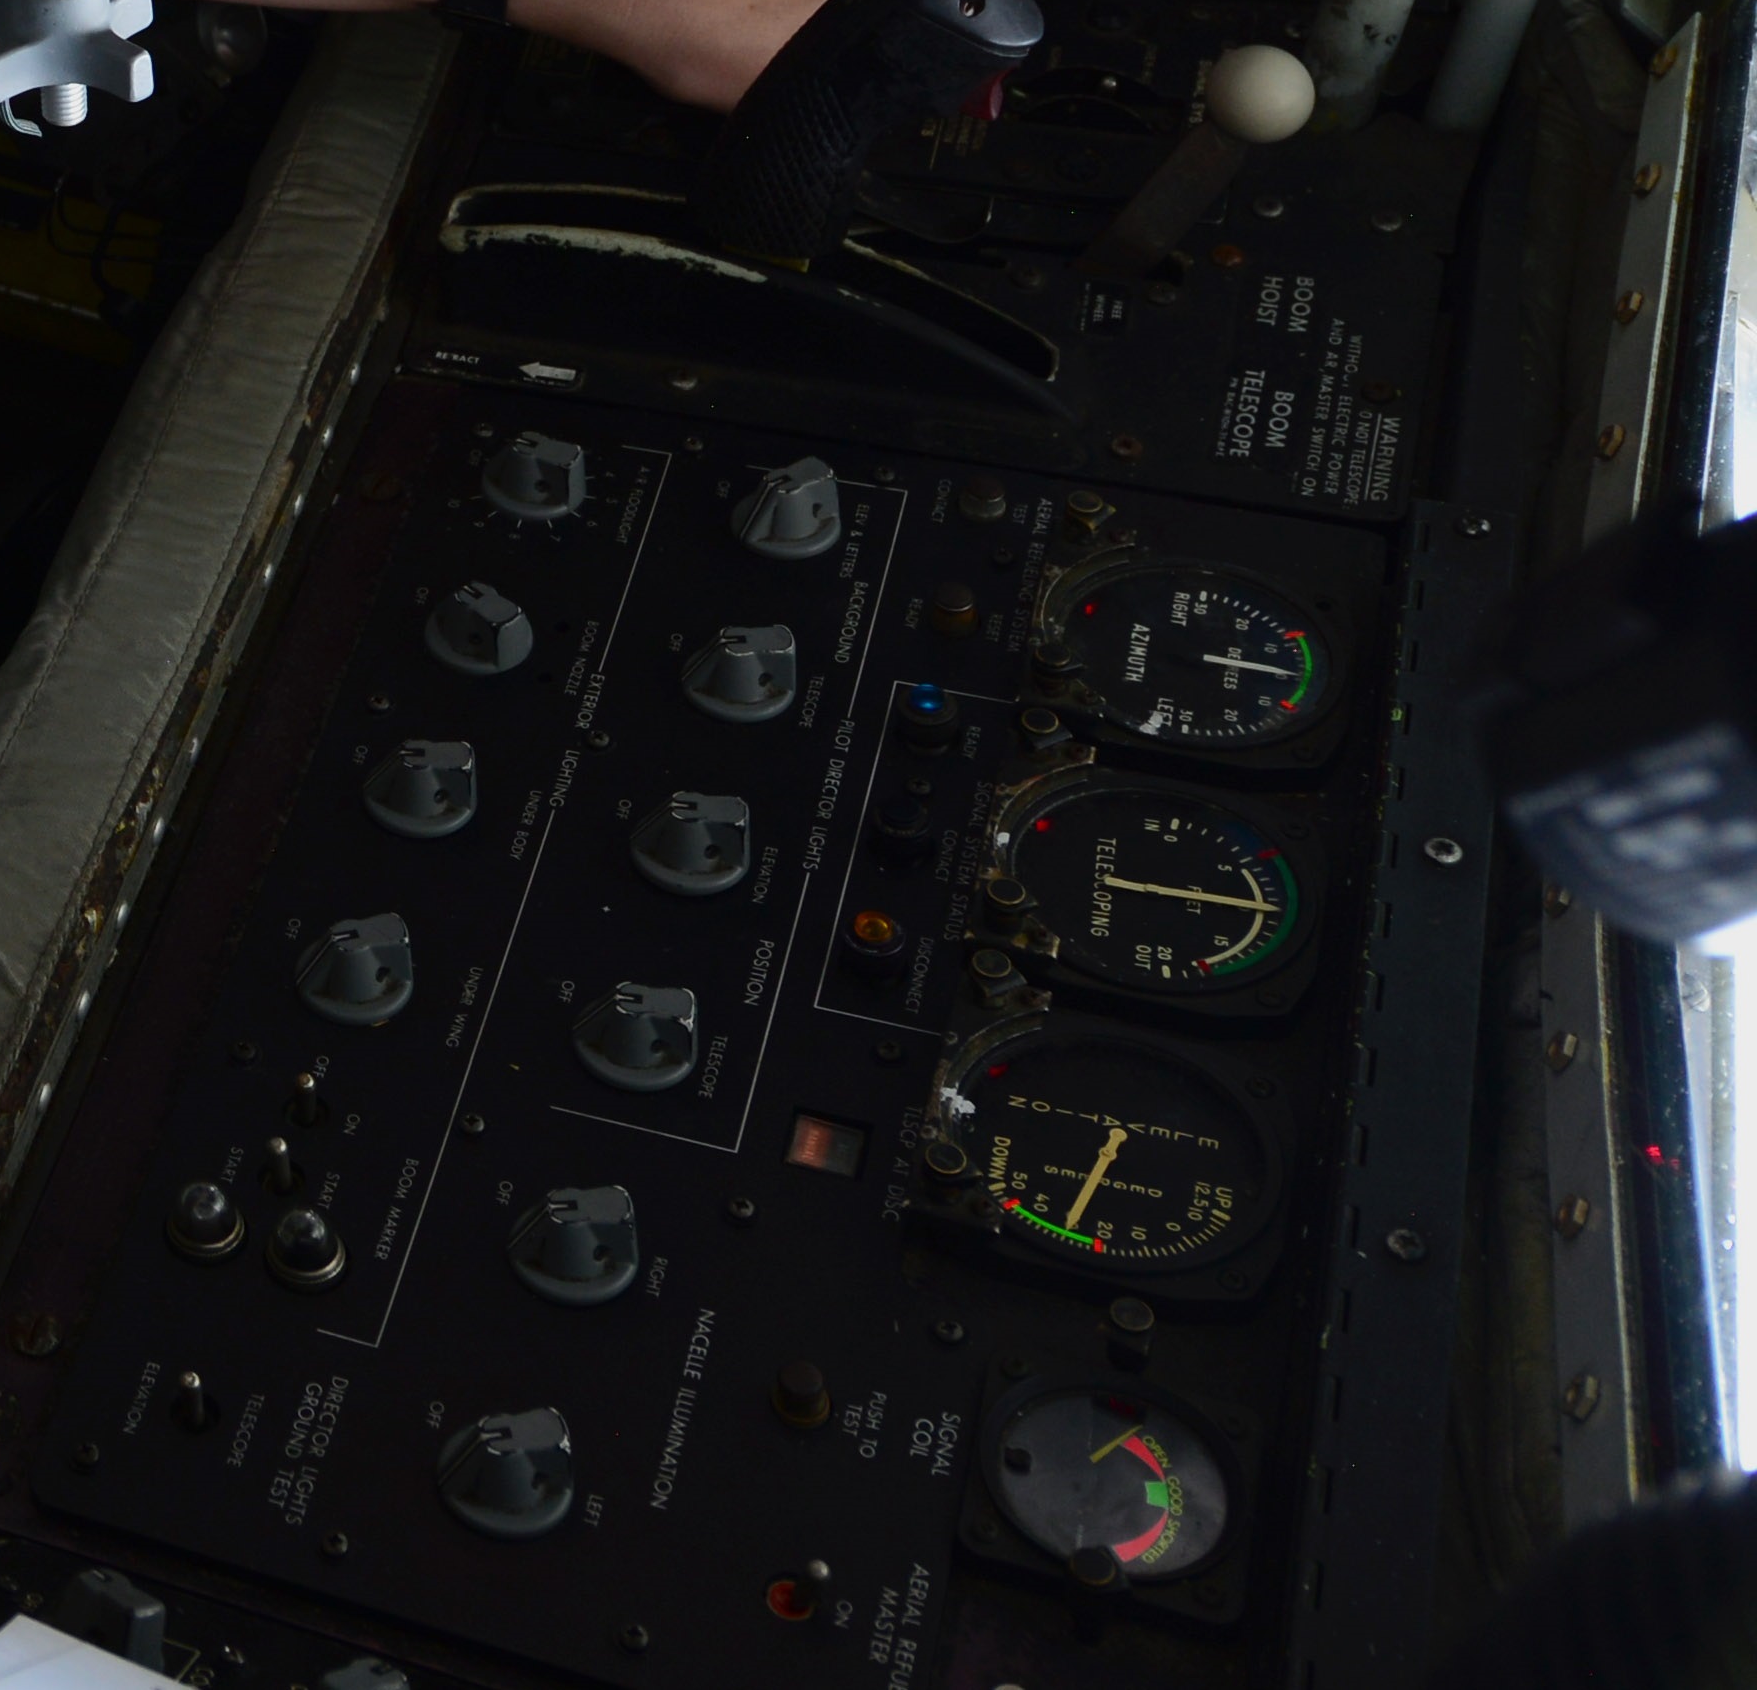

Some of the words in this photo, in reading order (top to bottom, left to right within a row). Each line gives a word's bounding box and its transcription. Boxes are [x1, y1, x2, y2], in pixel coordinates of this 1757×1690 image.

[1111, 300, 1124, 320] FREE
[1256, 275, 1284, 326] HOIST
[1287, 275, 1315, 333] BOOM
[1328, 317, 1346, 346] AND
[1342, 334, 1363, 388] WITHO
[1229, 369, 1266, 458] TELESCOPE
[1313, 374, 1335, 420] MASTER
[1265, 390, 1295, 448] BOOM
[1331, 395, 1353, 447] ELECTRIC
[1355, 419, 1370, 446] NOT
[1306, 426, 1326, 471] SWITCH
[1370, 417, 1402, 502] WARNING
[1301, 477, 1317, 498] ON
[1323, 451, 1344, 495] POWER
[616, 486, 645, 544] FLOODLIGHT
[854, 503, 871, 527] ELEV
[931, 478, 953, 524] CONTACT
[1012, 504, 1029, 525] TEST
[1031, 497, 1053, 535] AERIAL
[850, 530, 865, 540] &
[839, 543, 861, 580] LETTERS
[1018, 542, 1045, 601] REFUELING
[835, 581, 869, 664] BACKGROUND
[905, 598, 924, 630] READY
[1170, 591, 1191, 627] RIGHT
[1194, 601, 1209, 616] 30
[1235, 617, 1250, 631] 20
[580, 620, 600, 652] BOOM
[669, 633, 684, 653] OFF
[986, 614, 1004, 644] RESET
[1264, 642, 1278, 654] 10
[1124, 623, 1151, 683] AZIMUTH
[1223, 647, 1242, 691] DEEES
[565, 654, 588, 696] NOZZLE
[575, 673, 605, 730] EXTERIOR
[799, 676, 825, 729] TELESCOPE
[1157, 697, 1174, 728] LEFT
[1179, 709, 1194, 722] 30
[1223, 708, 1240, 722] 20
[1258, 696, 1272, 707] 10
[352, 744, 369, 766] OFF
[834, 720, 855, 753] PILOT
[961, 725, 982, 759] READY
[549, 749, 581, 807] LIGHTING
[816, 758, 846, 821] DIRECTOR
[520, 790, 542, 827] UNDER
[617, 798, 632, 821] OFF
[967, 782, 994, 838] SIGNAL
[1144, 818, 1161, 833] IN
[509, 830, 530, 862] BODY
[802, 826, 829, 871] LIGHTS
[934, 829, 958, 883] CONTACT
[1163, 834, 1178, 843] 0
[751, 845, 779, 905] ELEVATION
[955, 836, 980, 886] SYSTEM
[1217, 864, 1233, 873] 5
[943, 893, 969, 942] STATUS
[1186, 885, 1203, 916] FET
[285, 918, 302, 942] OFF
[1213, 934, 1229, 948] 15
[1134, 944, 1153, 971] OUT
[1156, 945, 1173, 961] 20
[459, 966, 484, 1006] UNDER
[557, 979, 576, 1004] OFF
[743, 939, 775, 1007] POSITION
[905, 937, 934, 1014] DISCONNECT
[445, 1014, 469, 1049] WING
[314, 1055, 330, 1080] OFF
[698, 1035, 728, 1100] TELESCOPE
[343, 1113, 361, 1137] ON
[899, 1106, 923, 1150] TLSCP
[1008, 1095, 1220, 1150] ELEVATION
[221, 1146, 245, 1186] START
[988, 1135, 1012, 1182] DOWN
[318, 1172, 341, 1210] START
[393, 1158, 420, 1199] BOOM
[495, 1180, 514, 1207] OFF
[1011, 1170, 1029, 1191] 50
[1193, 1181, 1211, 1208] 12.5
[1033, 1193, 1050, 1213] 40
[1187, 1207, 1203, 1222] 10
[1215, 1186, 1233, 1210] UP
[373, 1205, 403, 1261] MARKER
[1096, 1220, 1114, 1241] 20
[1131, 1225, 1147, 1241] 10
[1166, 1221, 1181, 1233] 0
[645, 1254, 669, 1299] RIGHT
[683, 1307, 717, 1381] NACELLE
[122, 1361, 161, 1435] ELEVATION
[306, 1375, 350, 1459] DIRECTOR
[425, 1400, 446, 1431] OFF
[866, 1391, 887, 1430] PUSH
[227, 1392, 266, 1468] TELESCOPE
[285, 1382, 323, 1460] GROUND
[842, 1403, 863, 1438] TEST
[910, 1417, 935, 1458] COIL
[649, 1386, 698, 1511] ILLUMINATION
[859, 1438, 878, 1459] TO
[931, 1412, 961, 1477] SIGNAL
[1142, 1435, 1172, 1469] OPEN
[267, 1469, 295, 1510] TEST
[285, 1465, 320, 1527] LIGHTS
[1166, 1475, 1183, 1516] GOOD
[584, 1493, 605, 1528] LEFT
[1142, 1519, 1181, 1564] SHORTED
[834, 1598, 853, 1629] ON
[901, 1562, 931, 1627] AERIAL
[869, 1585, 900, 1665] MASTER
